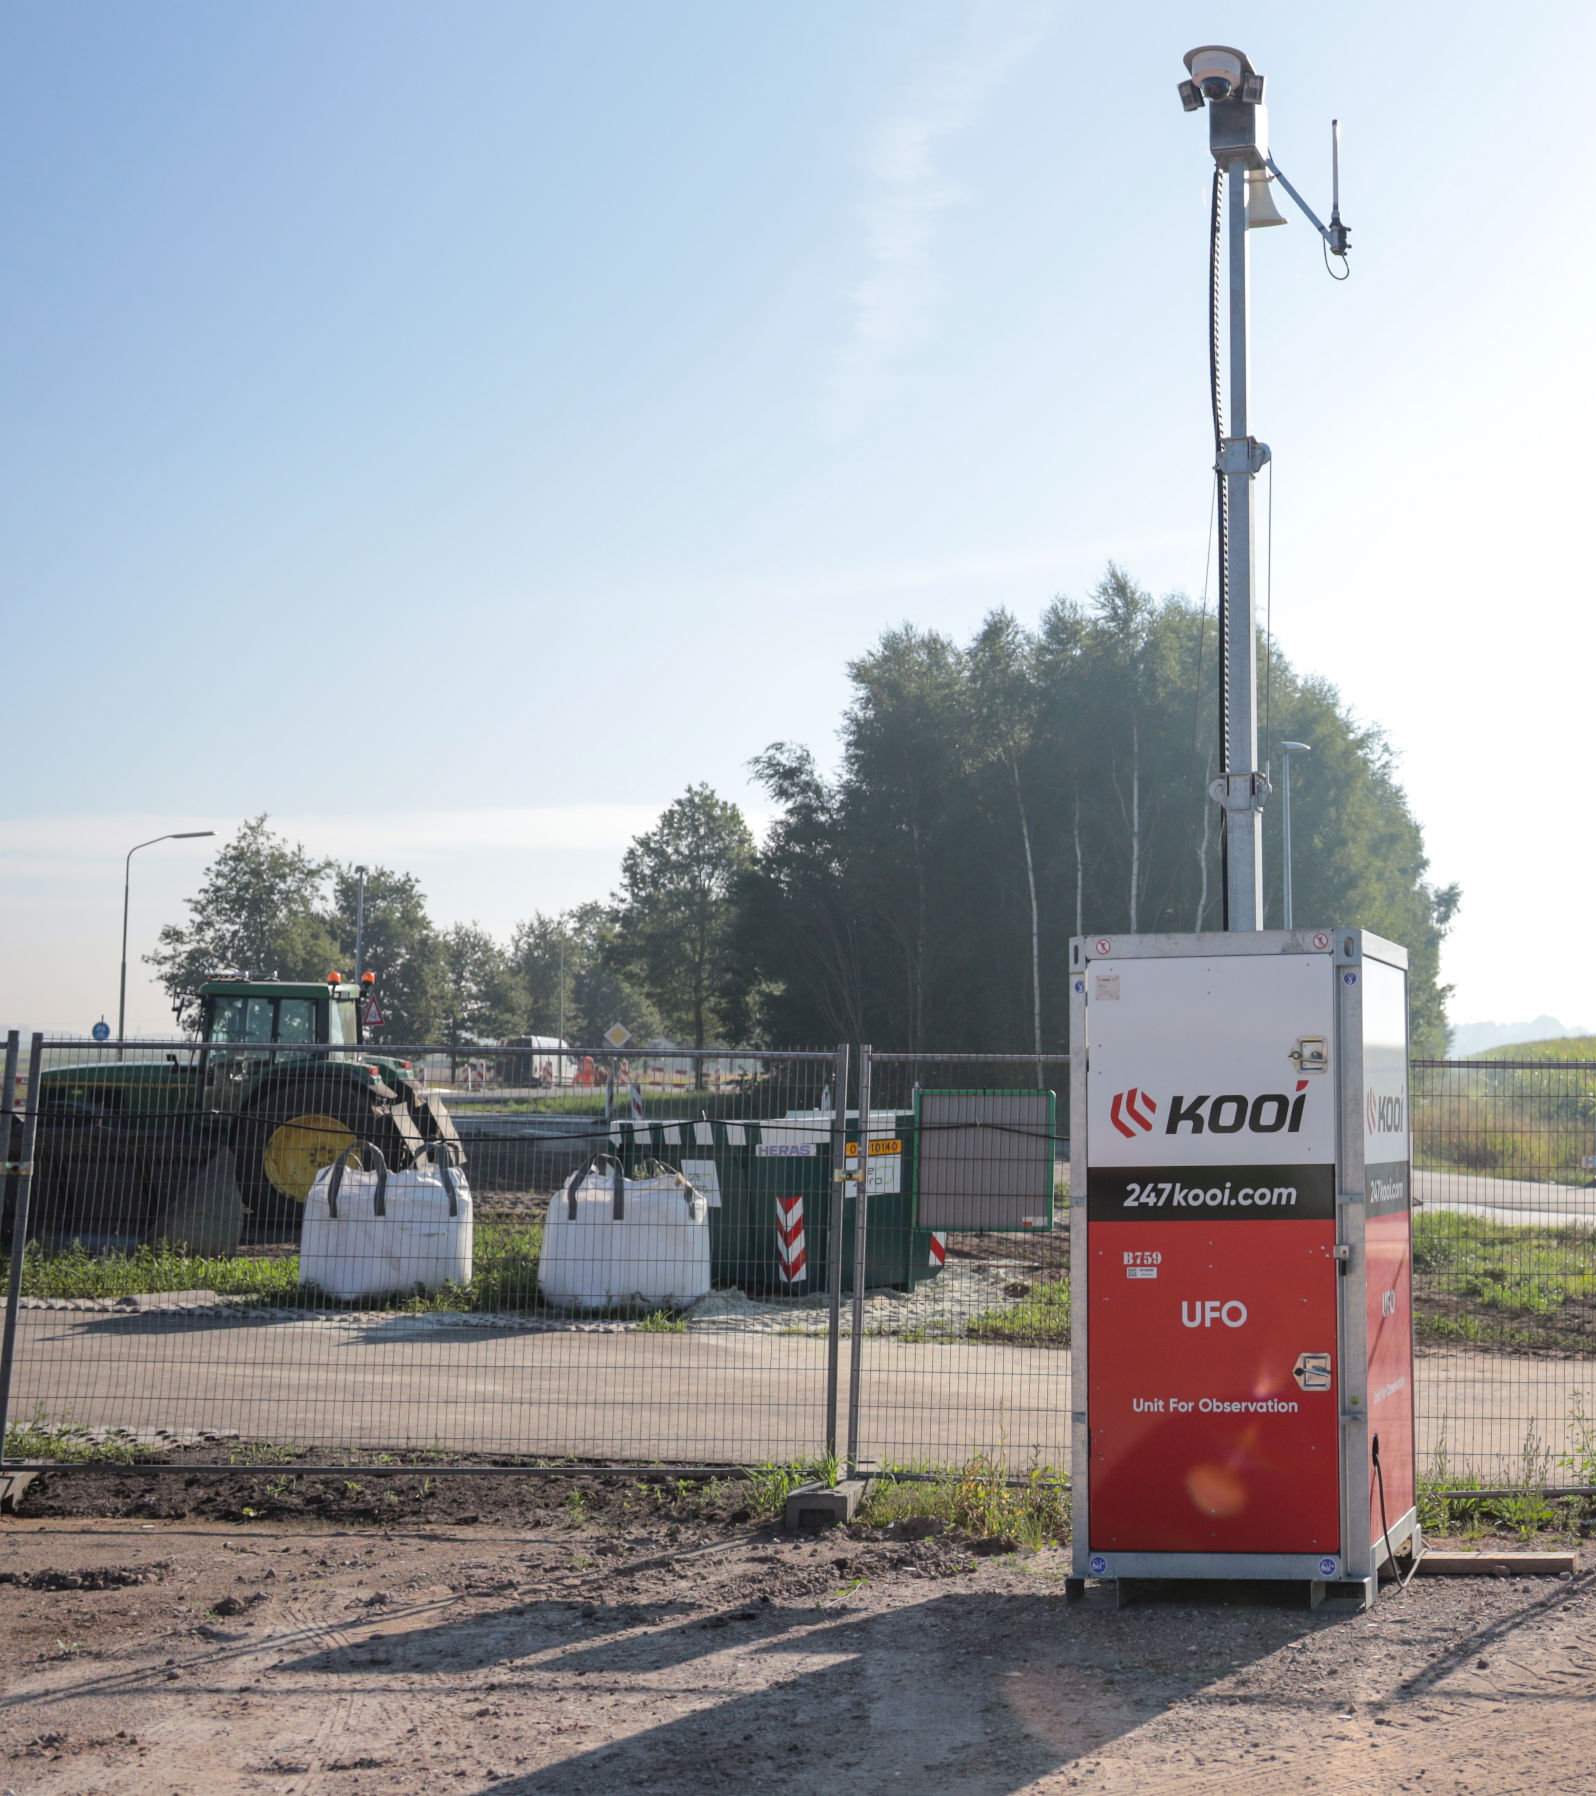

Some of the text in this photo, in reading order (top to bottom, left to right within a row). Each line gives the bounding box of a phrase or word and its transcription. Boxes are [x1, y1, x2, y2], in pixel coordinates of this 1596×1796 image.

[758, 1144, 811, 1156] HERAS
[871, 1141, 898, 1152] 10140
[1123, 1182, 1296, 1207] 247kooi.com
[1123, 1251, 1162, 1265] B759
[1382, 1289, 1396, 1317] UFO
[1181, 1300, 1248, 1328] UFO
[1132, 1398, 1299, 1413] Unit For Observation
